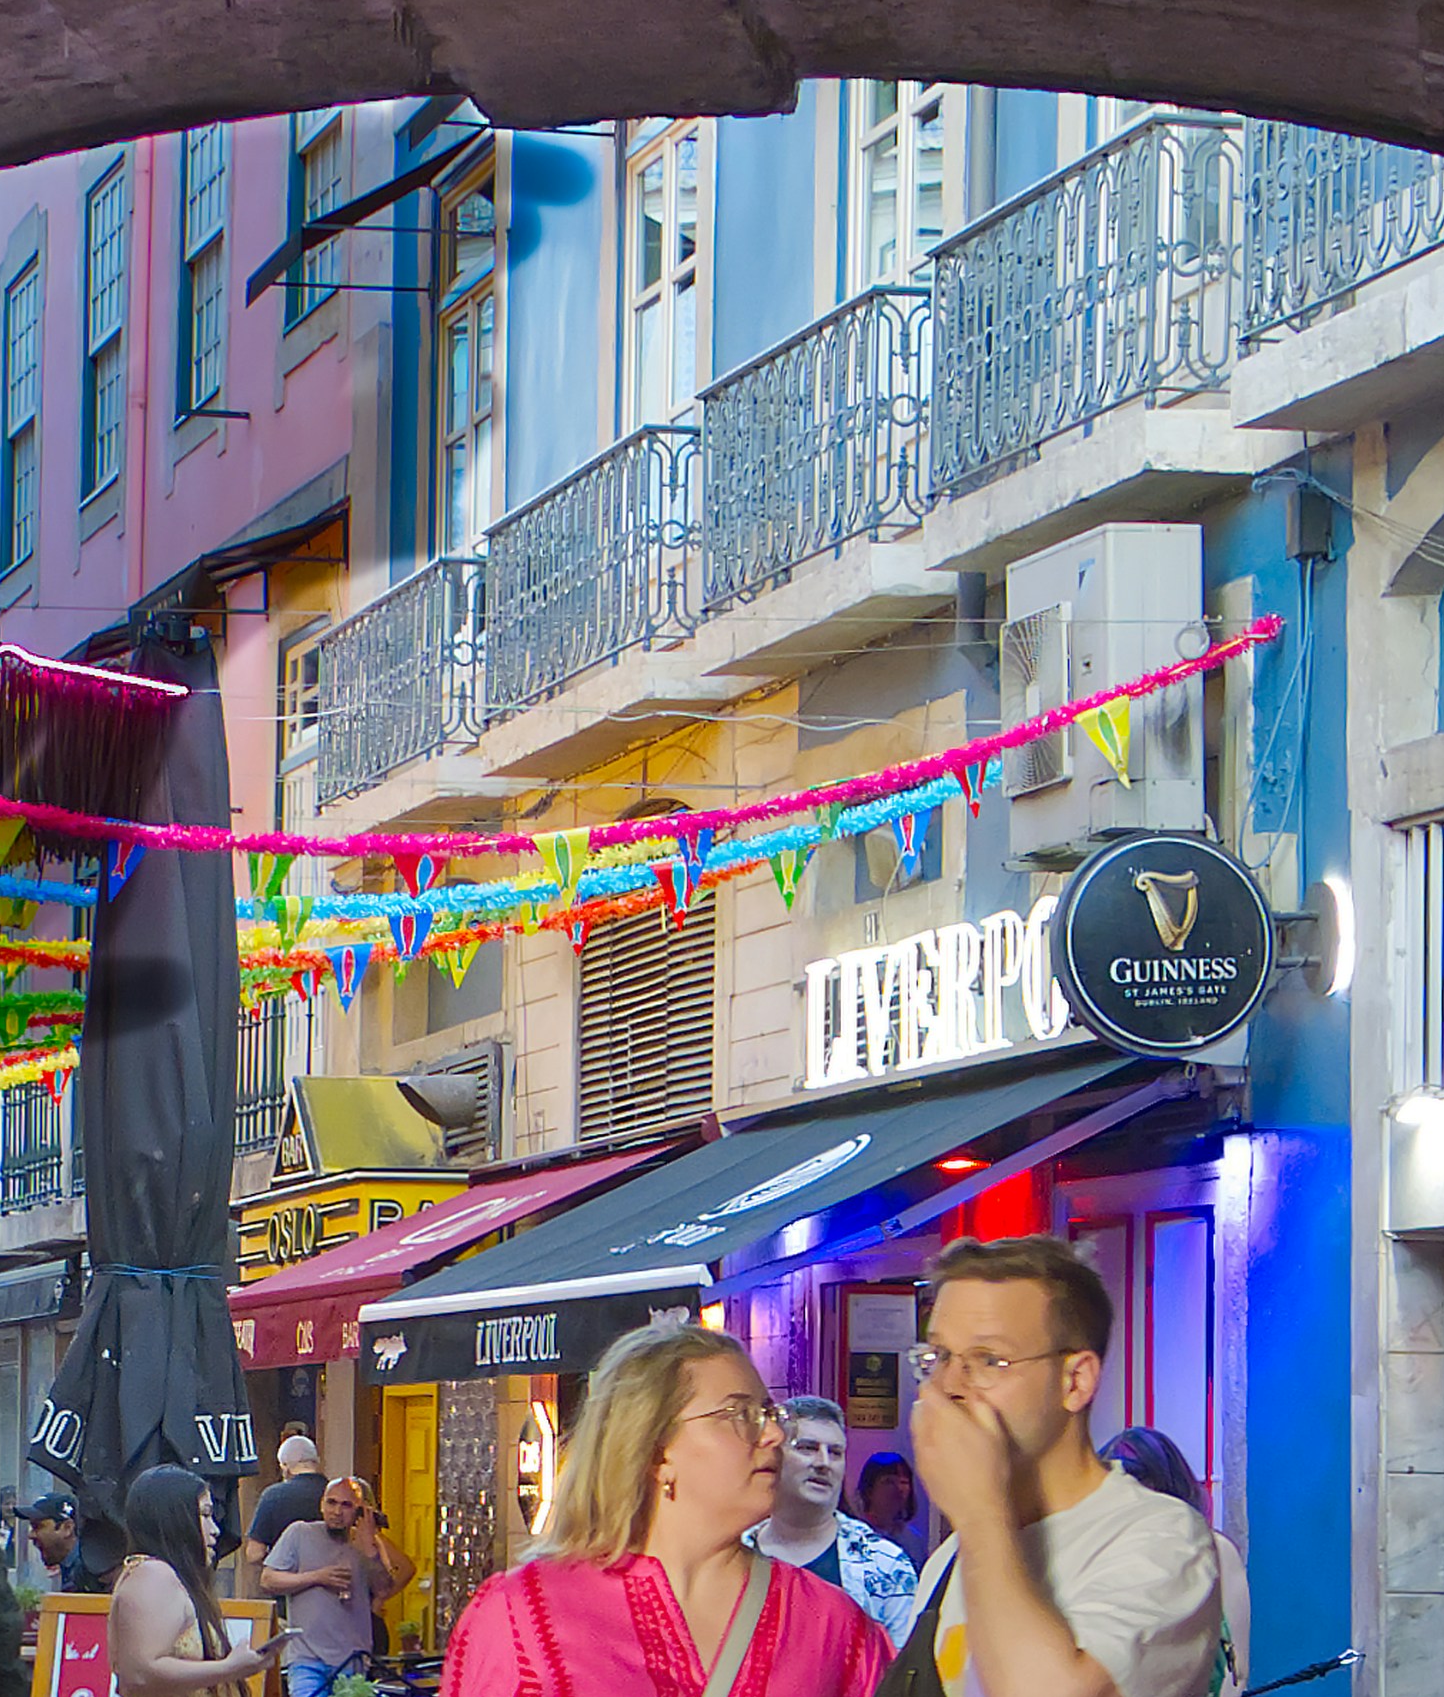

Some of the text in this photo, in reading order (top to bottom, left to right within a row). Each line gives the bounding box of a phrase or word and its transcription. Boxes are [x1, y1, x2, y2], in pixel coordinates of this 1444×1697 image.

[1110, 958, 1237, 983] GUINNESS
[282, 1134, 305, 1167] BAR
[267, 1204, 316, 1262] OSLO
[475, 1313, 560, 1366] LIVERPOOL
